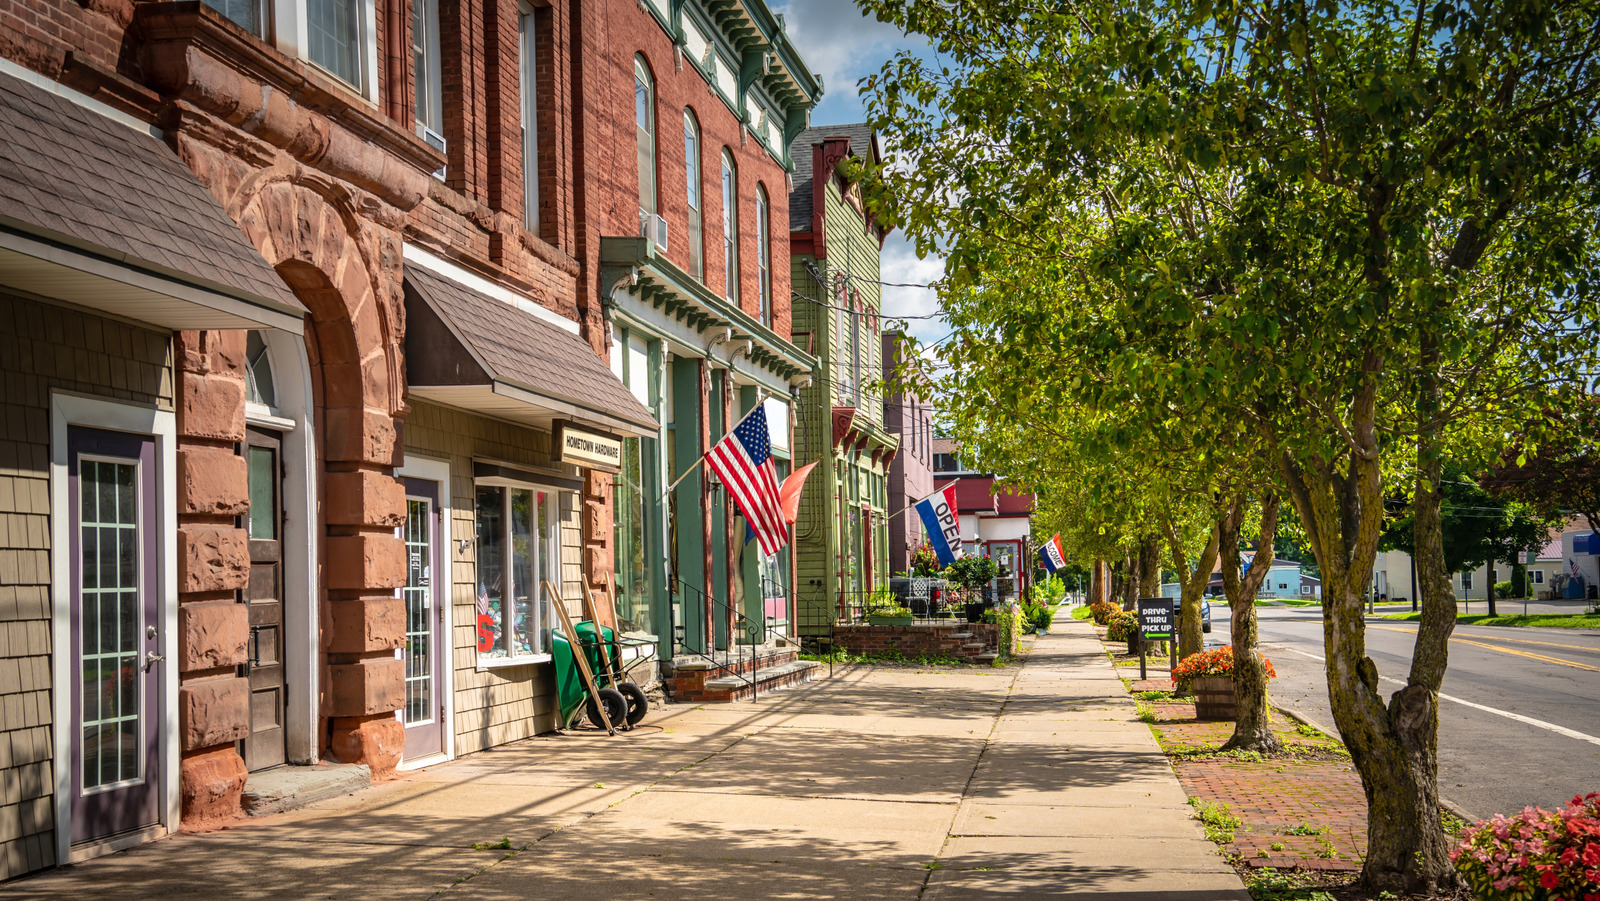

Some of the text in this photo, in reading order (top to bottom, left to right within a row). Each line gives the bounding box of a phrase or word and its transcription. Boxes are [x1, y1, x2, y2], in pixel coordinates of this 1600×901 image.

[566, 435, 619, 459] HOMETOWN HARDWARE
[935, 502, 962, 552] OPEN
[477, 614, 494, 652] S
[1145, 616, 1167, 624] THRU
